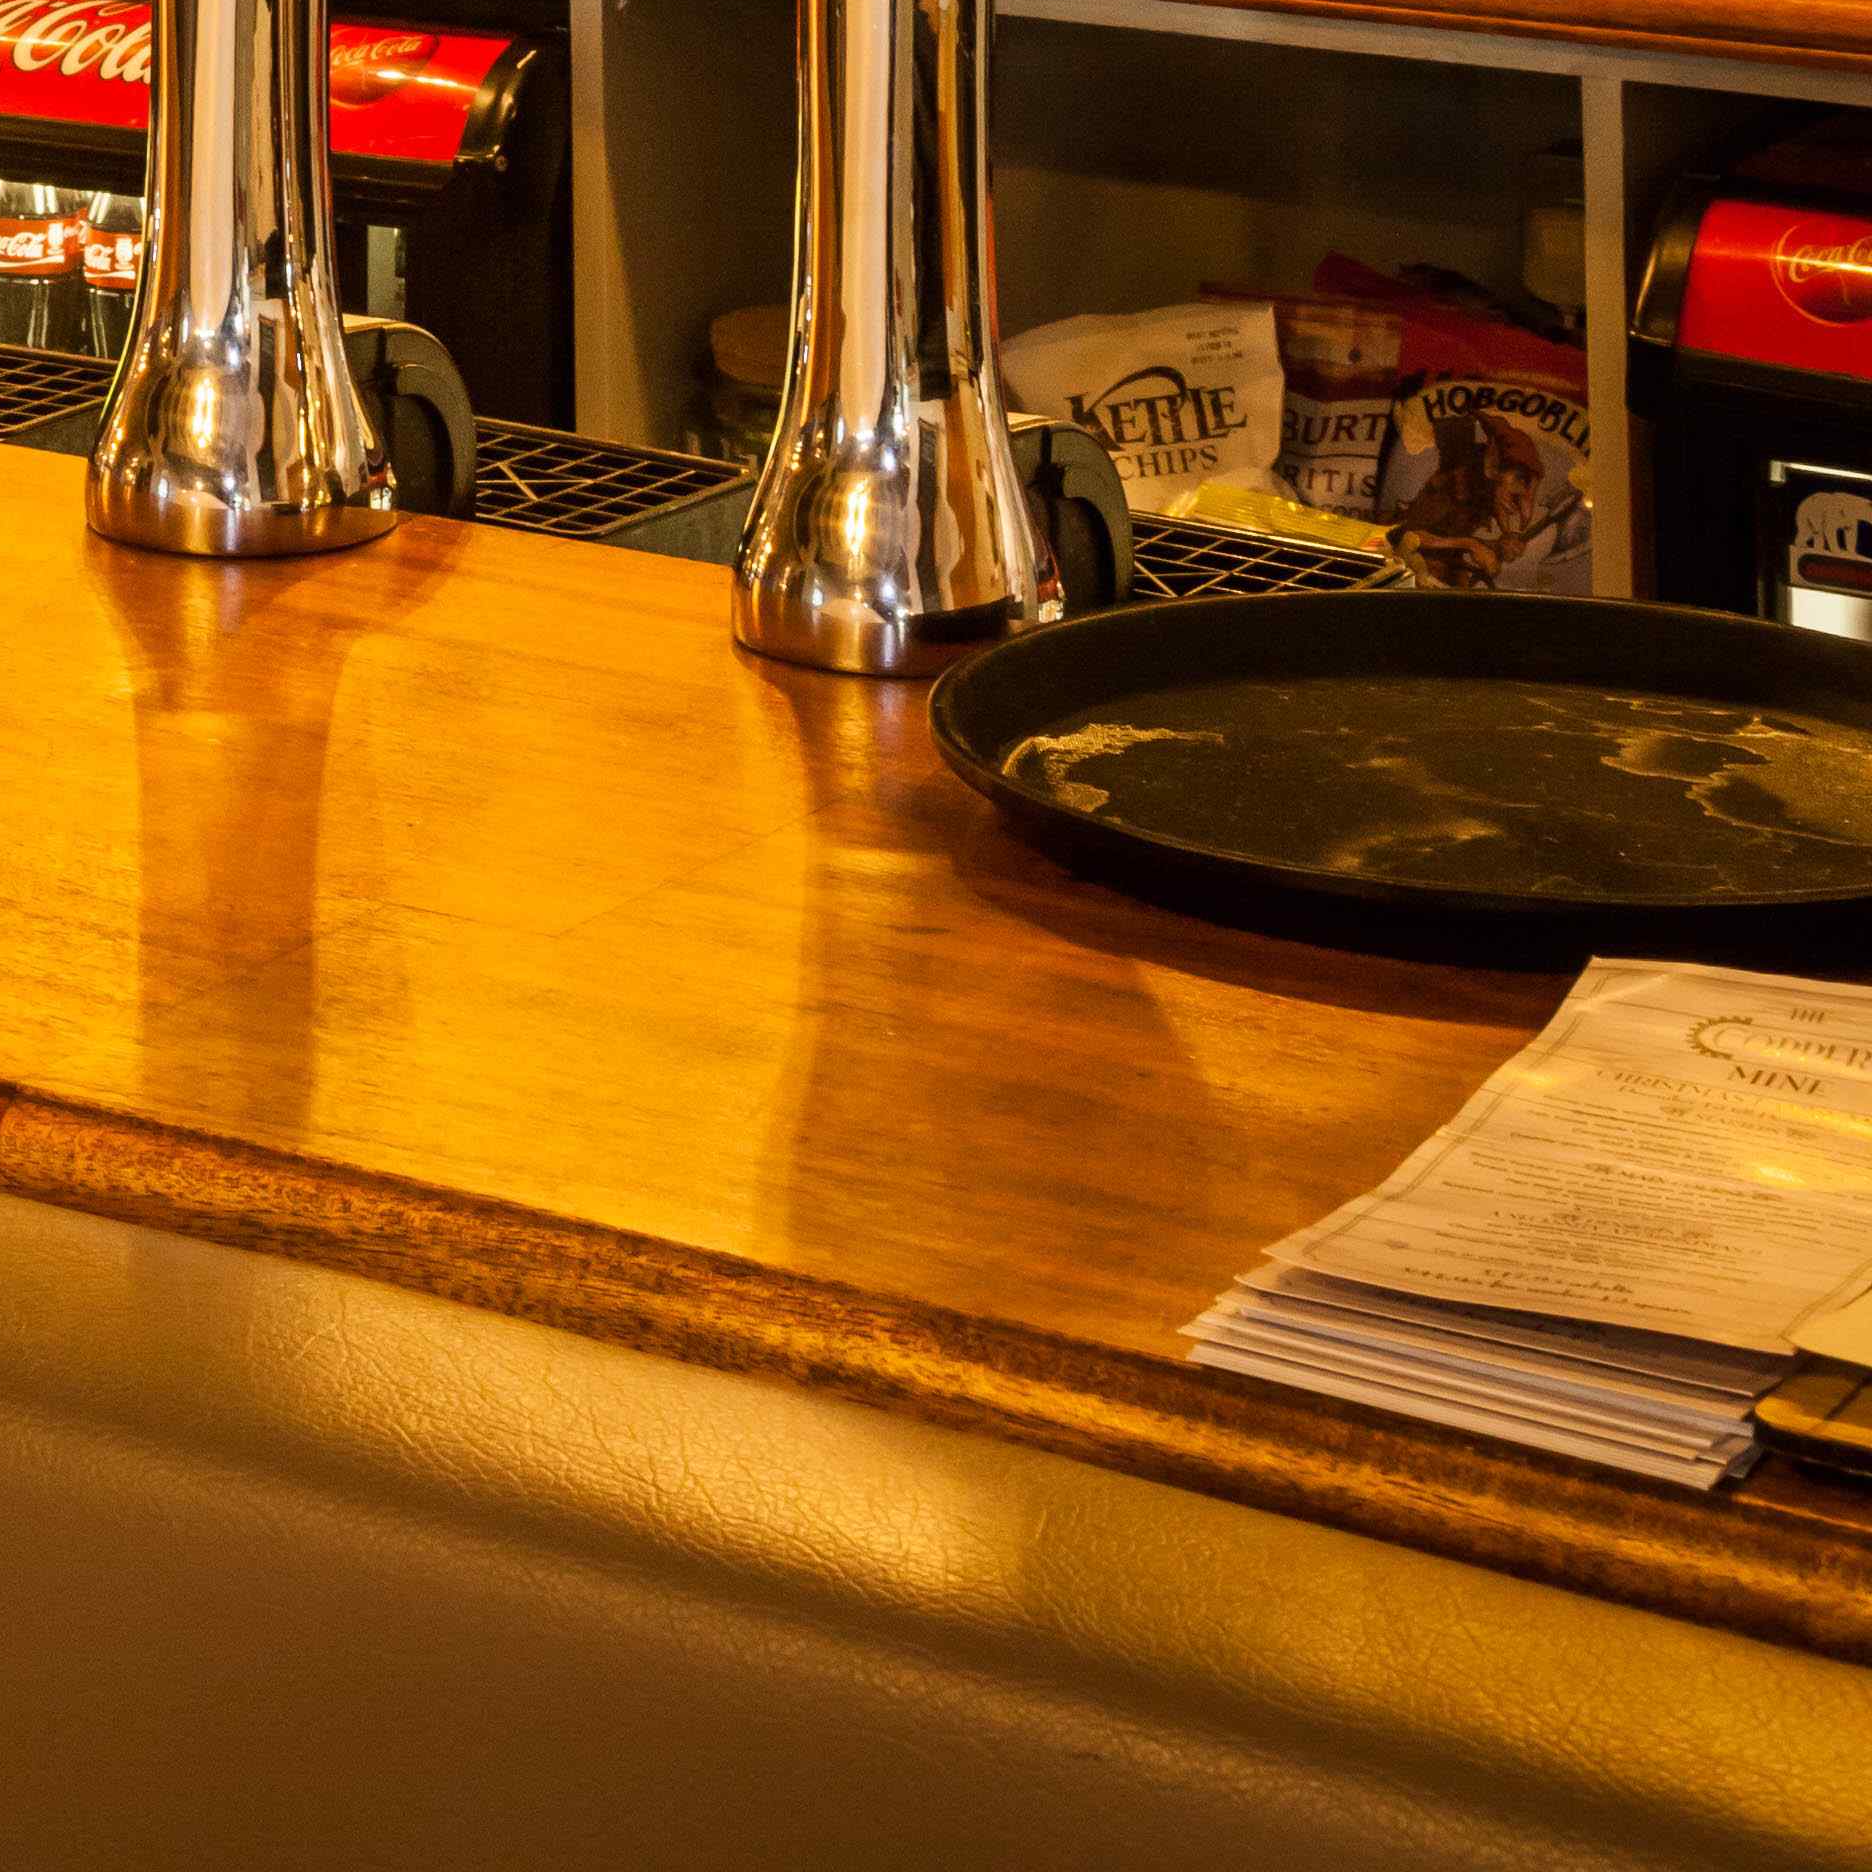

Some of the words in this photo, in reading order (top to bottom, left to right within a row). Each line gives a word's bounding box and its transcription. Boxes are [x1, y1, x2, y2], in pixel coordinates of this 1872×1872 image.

[1063, 366, 1248, 452] KETTLE
[1284, 411, 1389, 445] BURT
[1113, 444, 1219, 482] CHIPS
[1727, 1065, 1827, 1096] MINE
